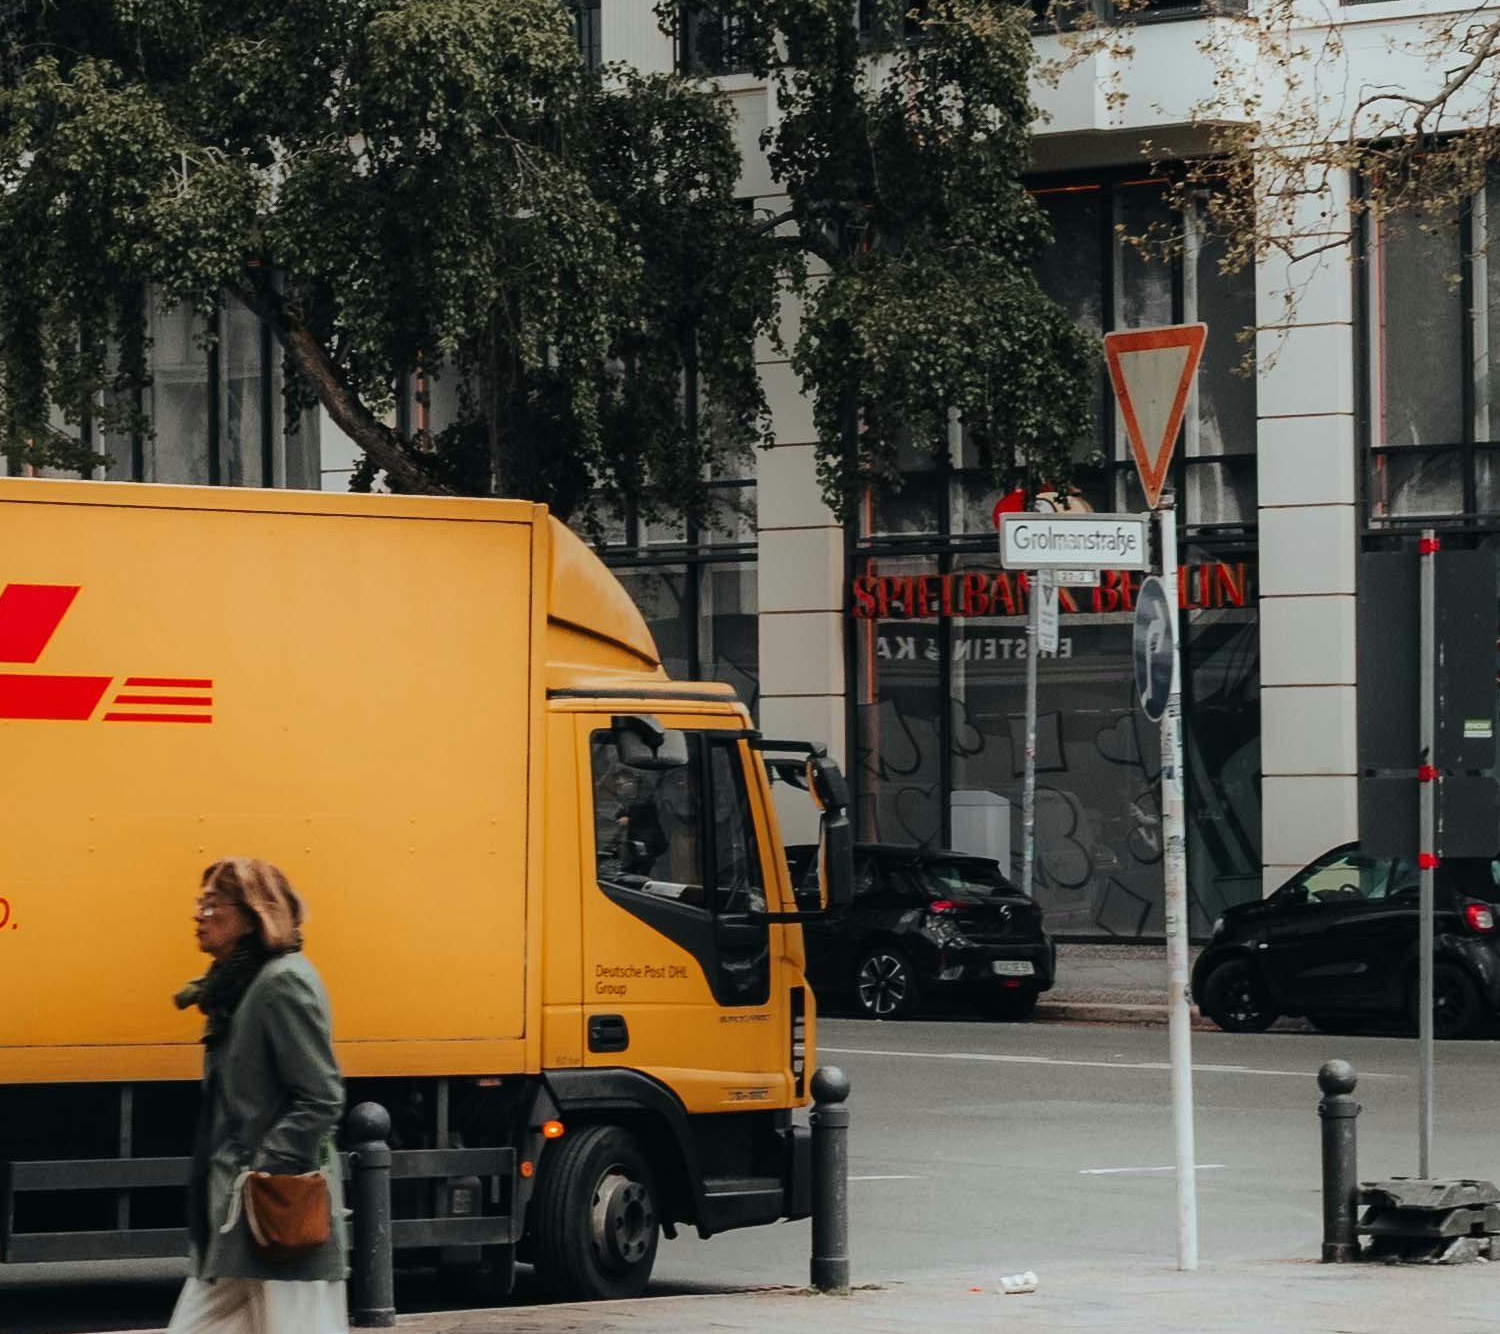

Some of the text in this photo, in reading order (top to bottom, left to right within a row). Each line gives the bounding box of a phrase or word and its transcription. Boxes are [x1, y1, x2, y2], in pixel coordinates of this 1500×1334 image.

[1013, 524, 1137, 557] Grolmanstraße
[1092, 563, 1244, 614] BELIN
[596, 965, 689, 979] Deutsche Post DHL
[596, 981, 627, 998] Group
